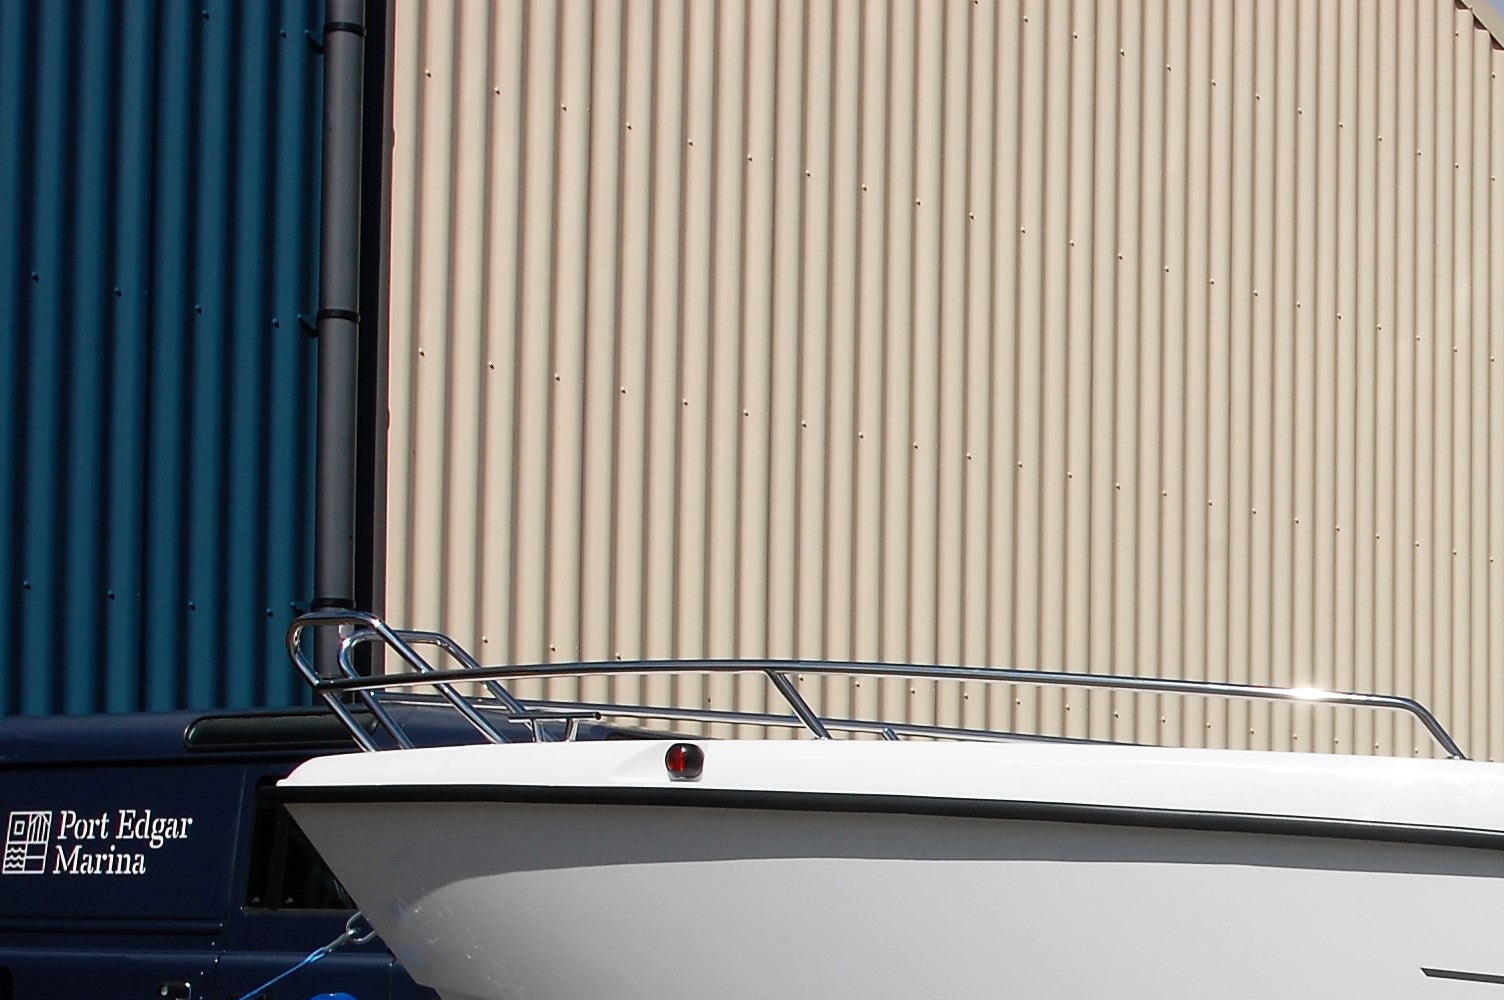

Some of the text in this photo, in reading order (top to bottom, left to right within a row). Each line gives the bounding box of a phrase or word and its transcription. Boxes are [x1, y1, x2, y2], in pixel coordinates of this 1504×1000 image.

[57, 809, 193, 849] Port Edgar
[52, 844, 147, 875] Marina
